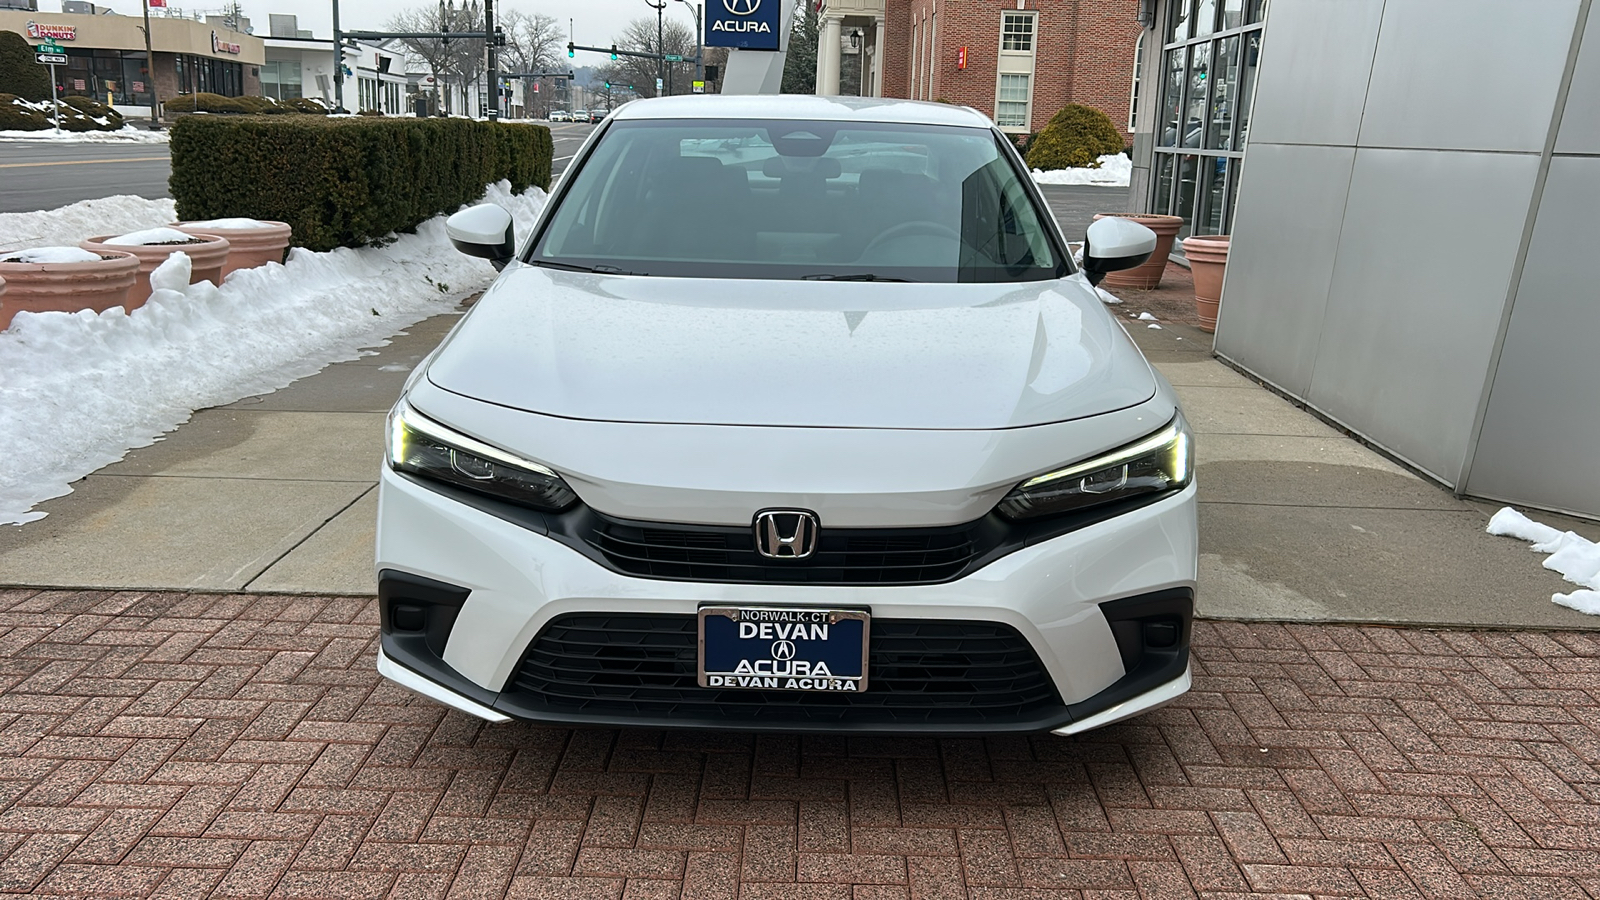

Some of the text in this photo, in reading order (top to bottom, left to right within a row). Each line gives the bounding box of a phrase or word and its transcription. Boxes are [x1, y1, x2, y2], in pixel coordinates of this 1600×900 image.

[40, 24, 75, 32] DUNKIN'
[711, 19, 771, 33] ACURA
[40, 31, 75, 39] DONUTS
[41, 45, 54, 53] Elm
[811, 612, 828, 623] CT
[739, 622, 829, 641] DEVAN
[733, 659, 833, 676] ACURA
[709, 676, 857, 691] DEVAN ACURA
